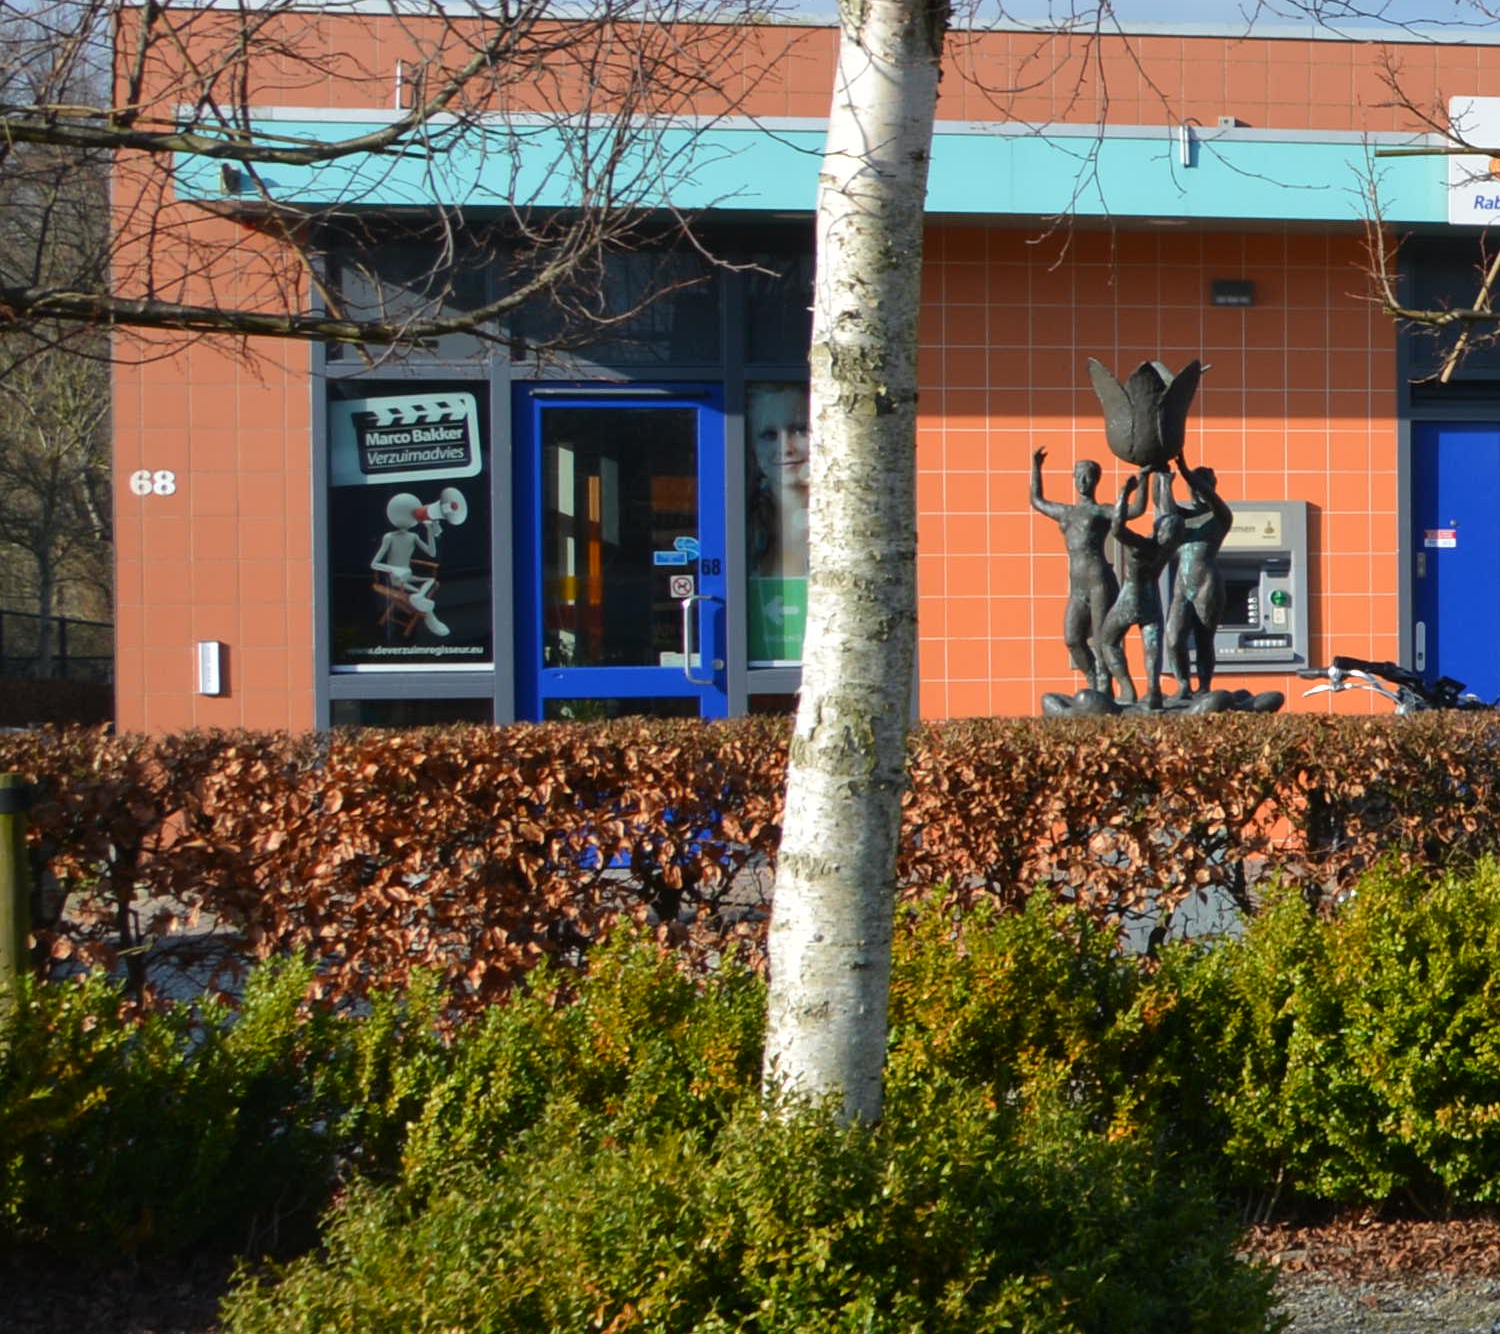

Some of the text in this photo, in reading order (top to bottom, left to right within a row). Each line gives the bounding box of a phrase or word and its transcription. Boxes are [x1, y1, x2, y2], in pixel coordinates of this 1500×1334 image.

[365, 428, 463, 446] Marco Bakker
[367, 447, 465, 465] Verzuimadvies
[130, 469, 176, 496] 68
[700, 558, 721, 576] 68
